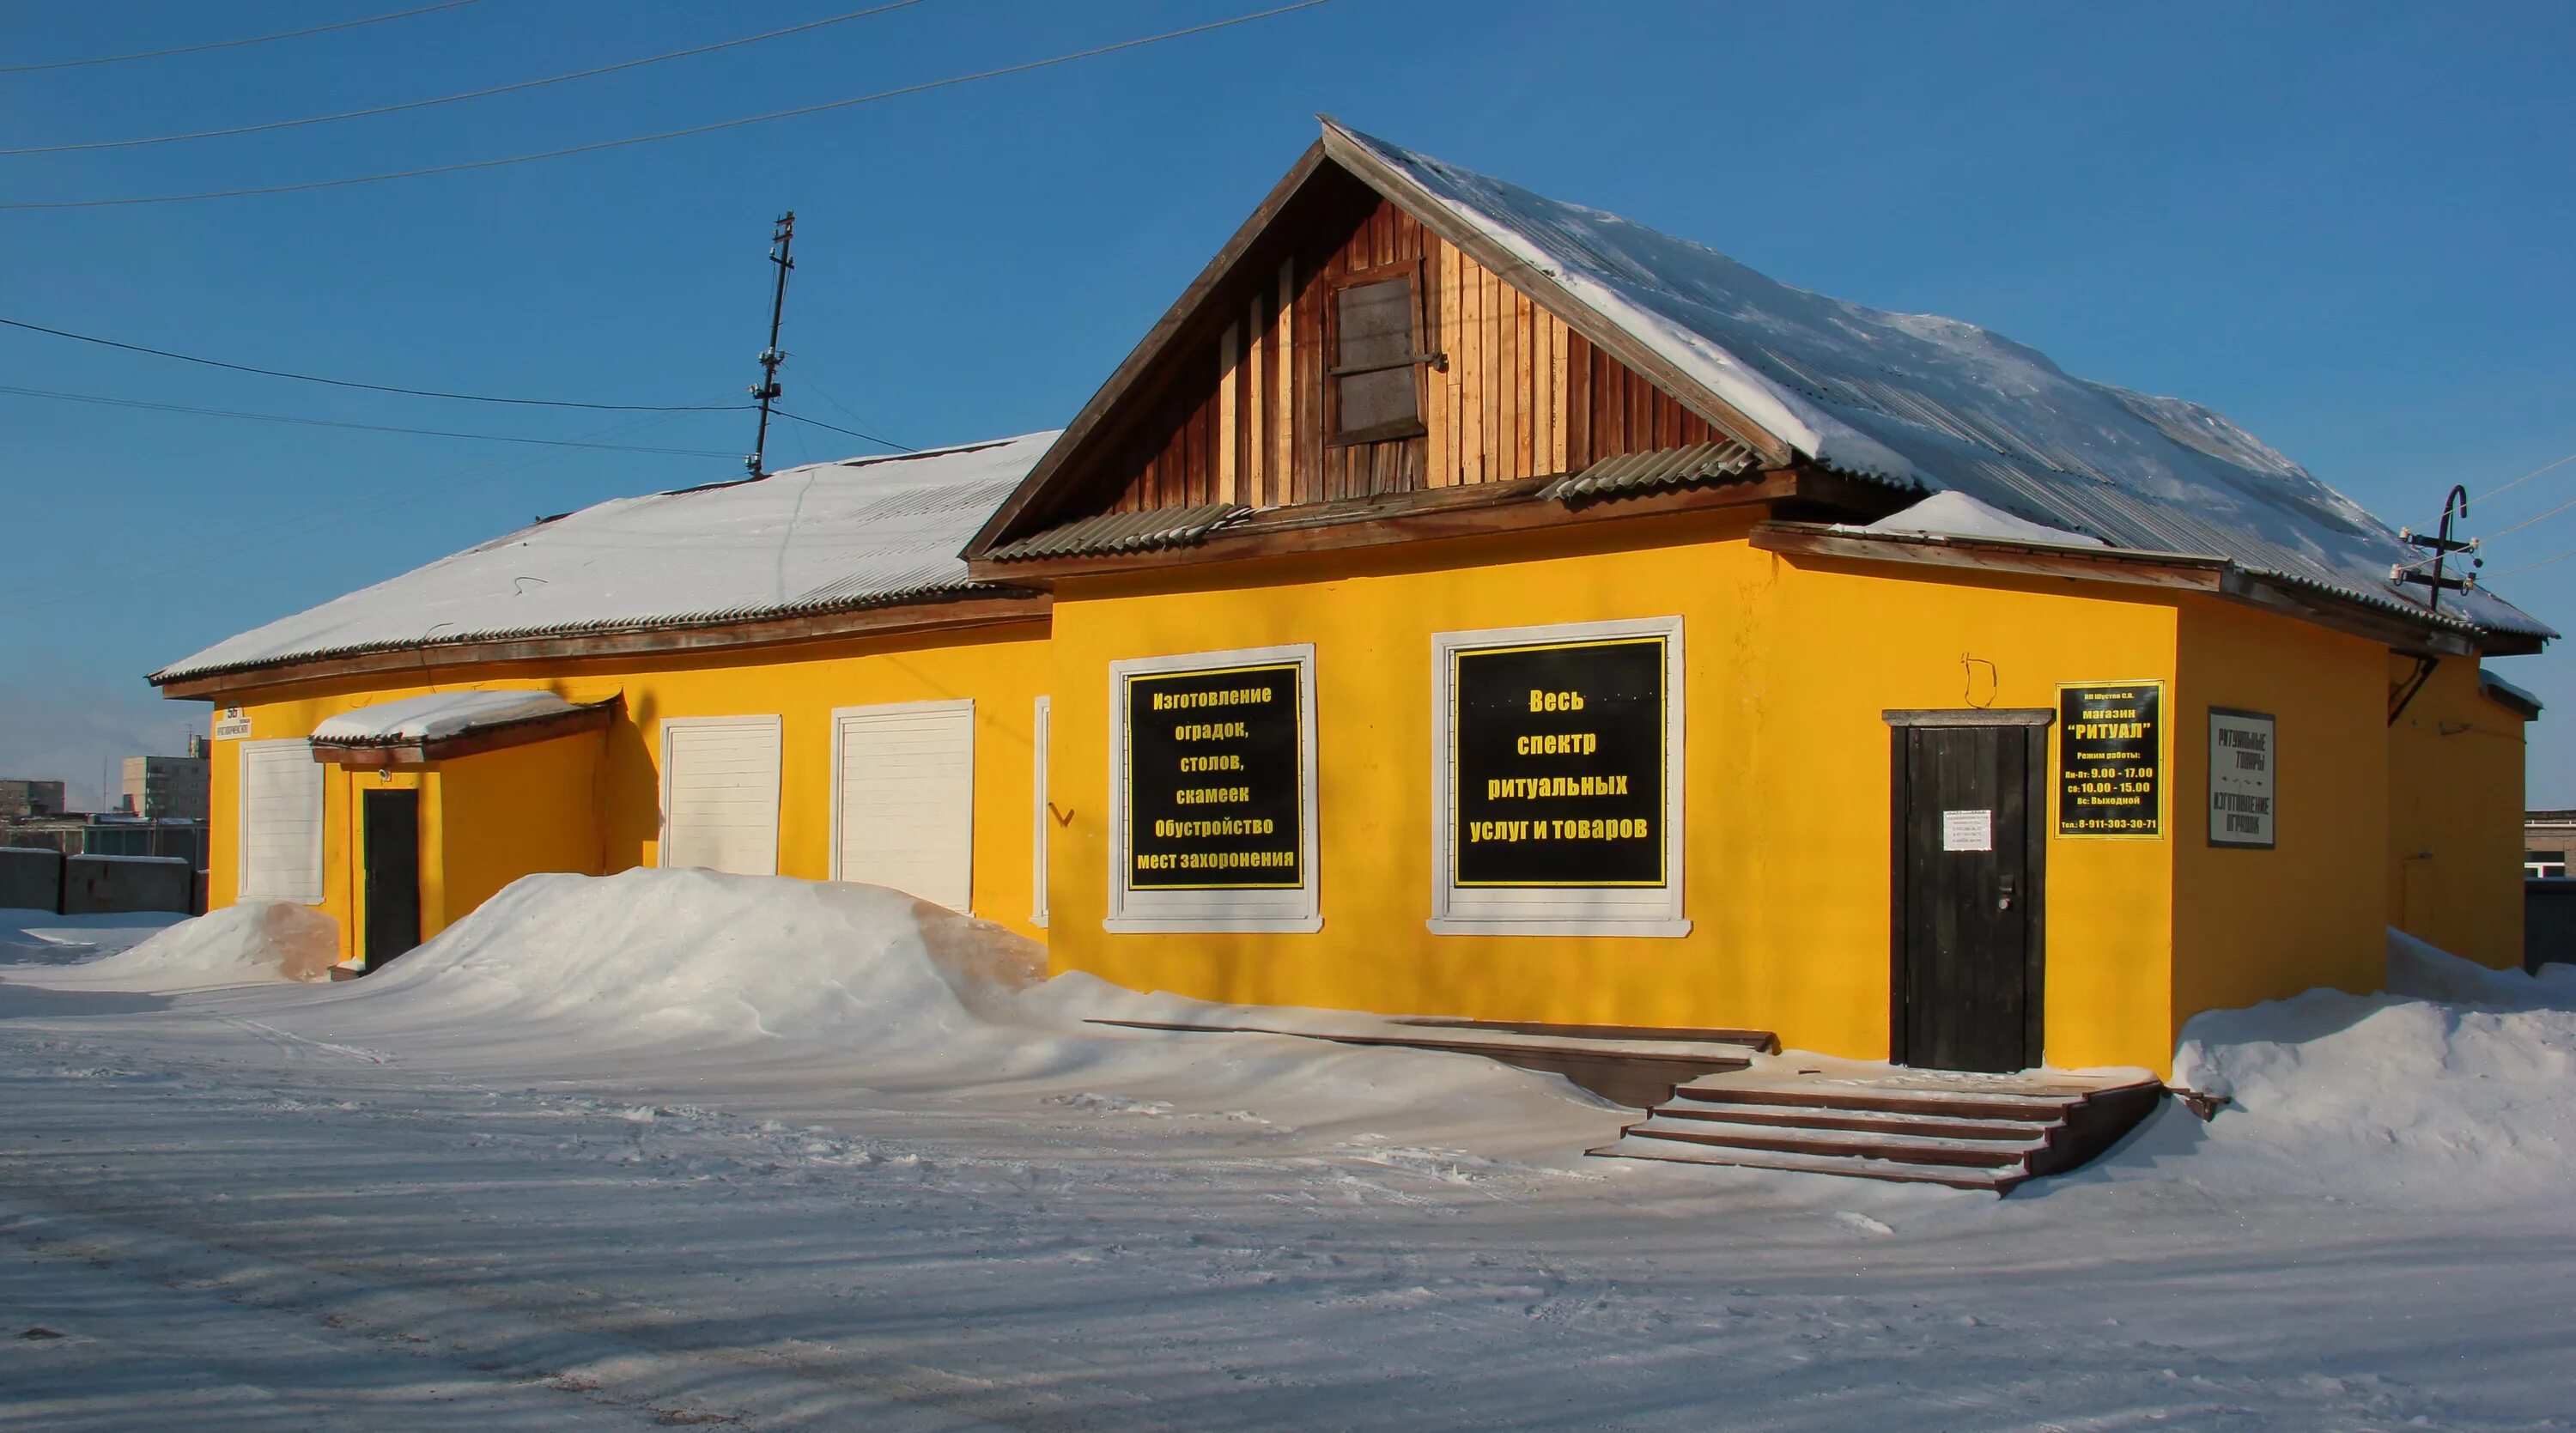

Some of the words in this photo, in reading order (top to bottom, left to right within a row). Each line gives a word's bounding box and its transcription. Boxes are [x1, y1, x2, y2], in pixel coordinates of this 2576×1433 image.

[1153, 688, 1272, 710] Изготовление
[1530, 689, 1584, 712] Весь
[2082, 709, 2136, 720] магазин
[1176, 721, 1249, 741] оградок,
[2068, 722, 2151, 739] “РИТУАЛ”
[2219, 728, 2267, 751] РИТУАЛЬНЫЕ
[1517, 733, 1596, 756] спектр
[1181, 756, 1244, 772] столов,
[2106, 751, 2141, 760] работы:
[2236, 750, 2265, 771] ТОВАРЫ
[2091, 768, 2116, 779] 9.00
[2124, 768, 2153, 778] 17.00
[1176, 787, 1249, 805] скамеек
[1488, 775, 1628, 800] ритуальных
[2068, 785, 2081, 793] Сб:
[2081, 783, 2111, 792] 10.00
[2120, 782, 2150, 792] 15.00
[2091, 796, 2141, 805] Выходной
[2214, 792, 2269, 815] ИЗГОТОВЛЕНИЕ
[1155, 817, 1273, 839] Обустройство
[1470, 820, 1528, 842] услуг
[1534, 821, 1547, 839] и
[1552, 818, 1648, 841] товаров
[2079, 819, 2156, 829] 8-911-303-30-71
[2227, 814, 2259, 834] ОГРАДОК
[1138, 853, 1176, 870] мест
[1180, 851, 1294, 869] захоронения
